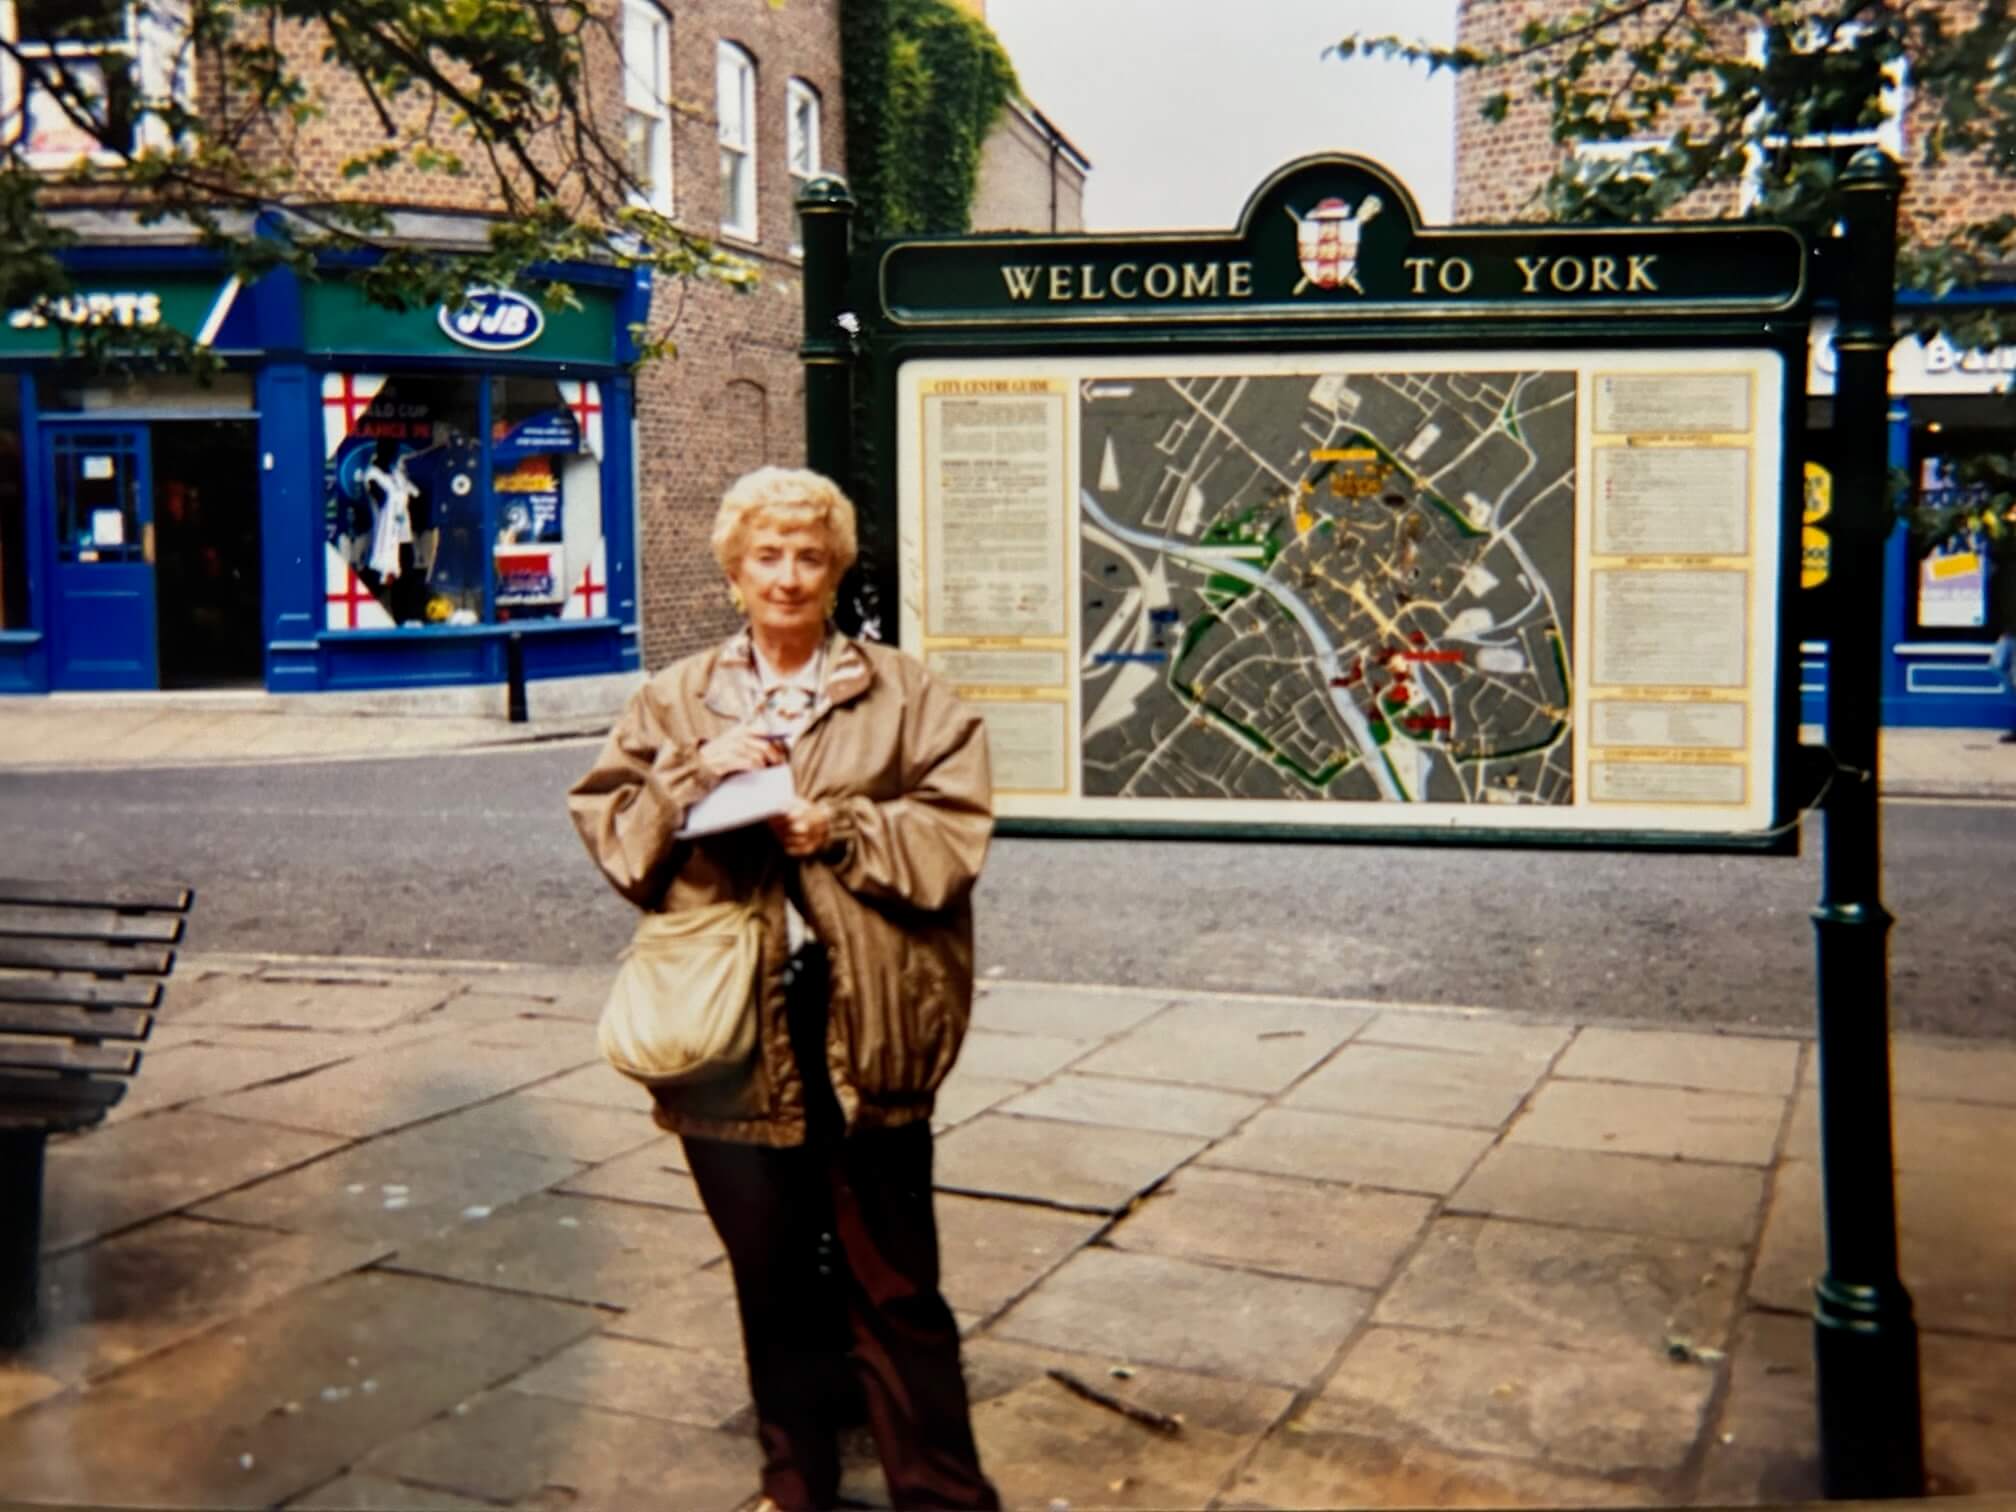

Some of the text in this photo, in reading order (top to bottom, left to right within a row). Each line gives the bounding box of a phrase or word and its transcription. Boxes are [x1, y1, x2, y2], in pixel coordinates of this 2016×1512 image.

[1001, 254, 1659, 300] WELCOME TO YORK
[456, 302, 530, 335] JJB
